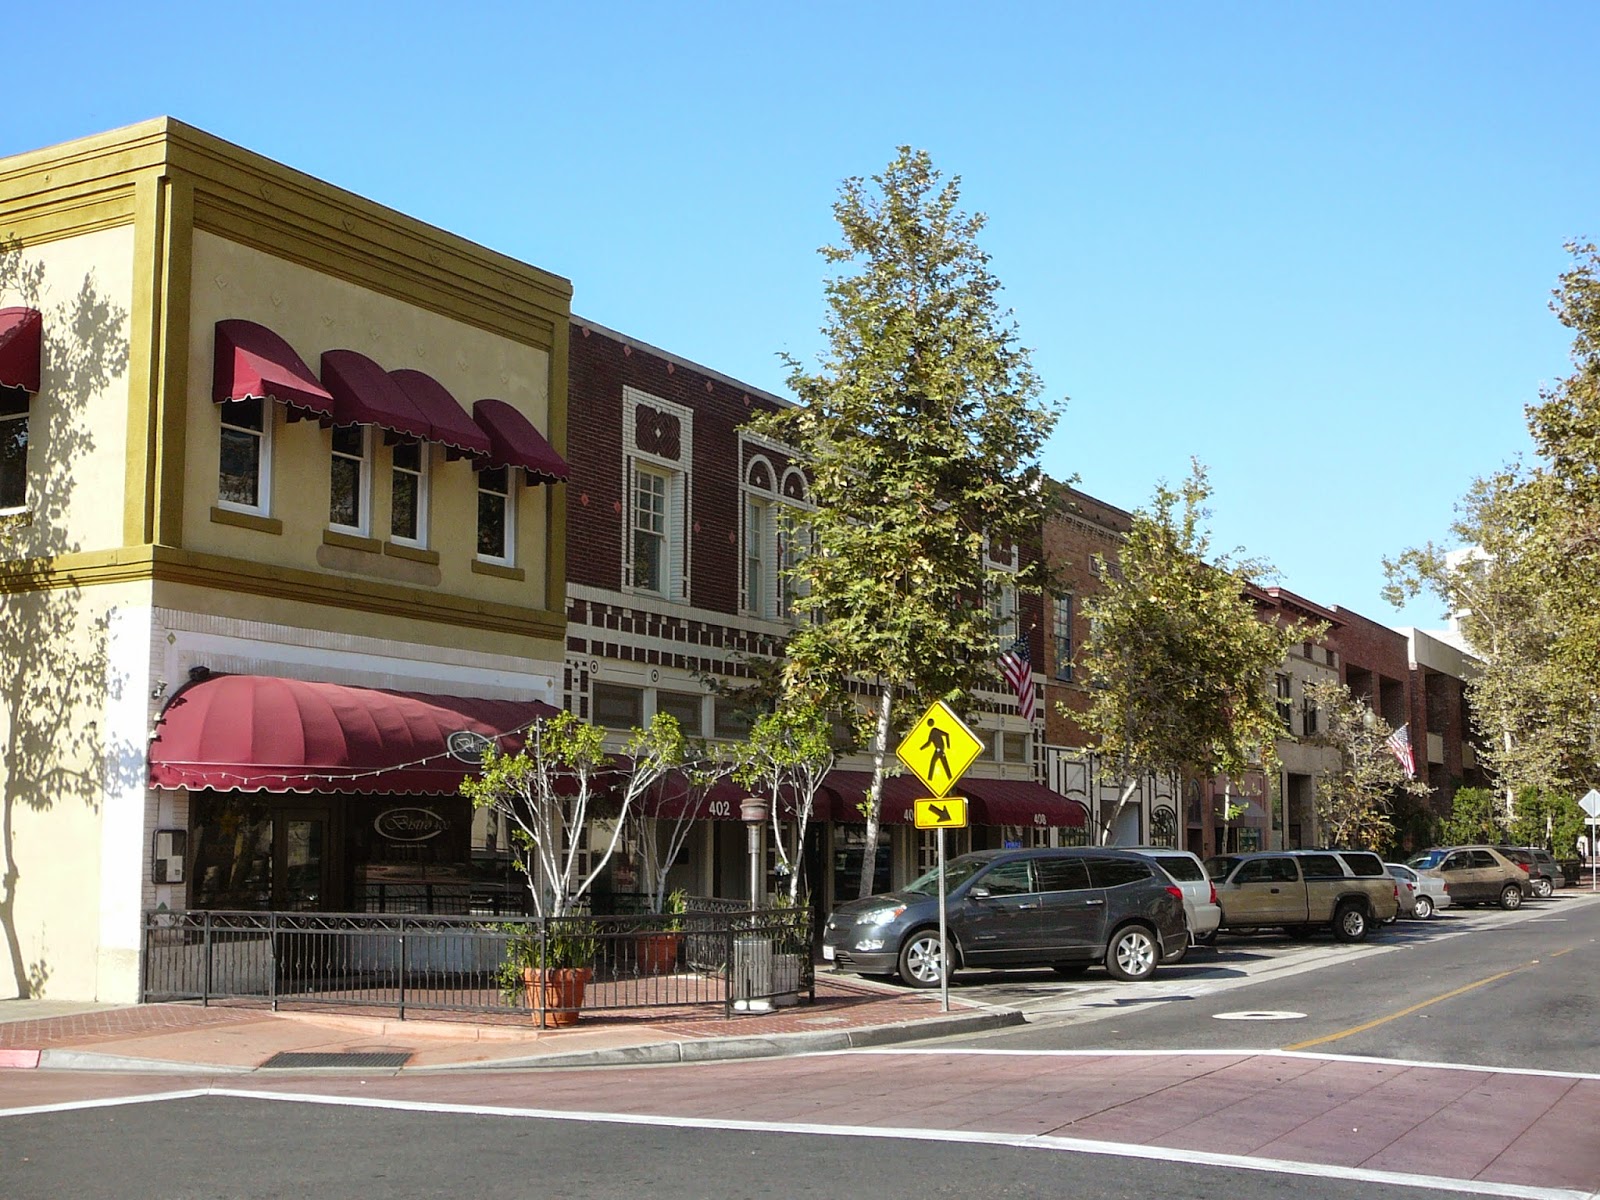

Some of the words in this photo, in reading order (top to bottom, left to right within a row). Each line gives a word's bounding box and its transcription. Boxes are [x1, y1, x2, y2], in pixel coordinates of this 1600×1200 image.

[709, 801, 730, 816] 402
[385, 815, 432, 831] Bistro
[1034, 813, 1047, 825] 408
